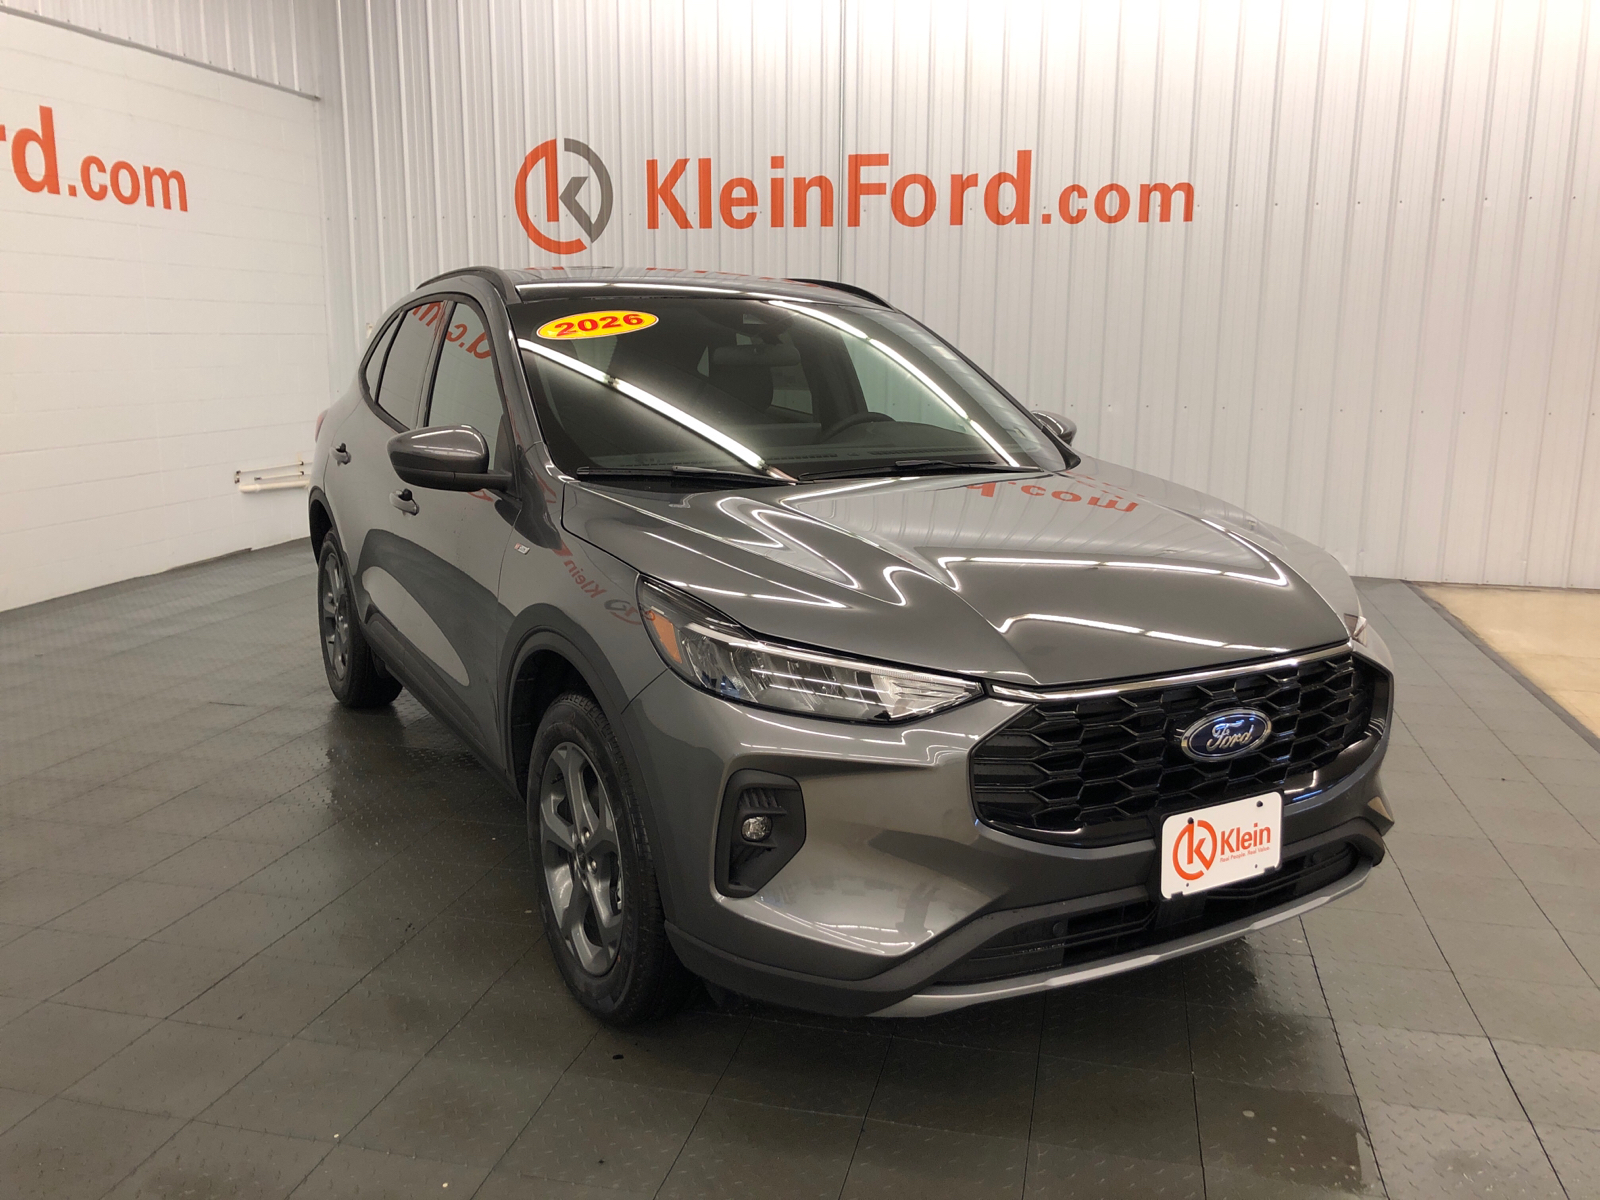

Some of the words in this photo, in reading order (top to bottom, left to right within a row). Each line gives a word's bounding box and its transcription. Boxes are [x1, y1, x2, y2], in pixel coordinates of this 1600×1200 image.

[0, 105, 188, 212] d.com
[646, 149, 1195, 229] KleinFord.com
[555, 312, 646, 337] 2026
[1206, 720, 1254, 752] Ford
[1220, 822, 1271, 856] Klein
